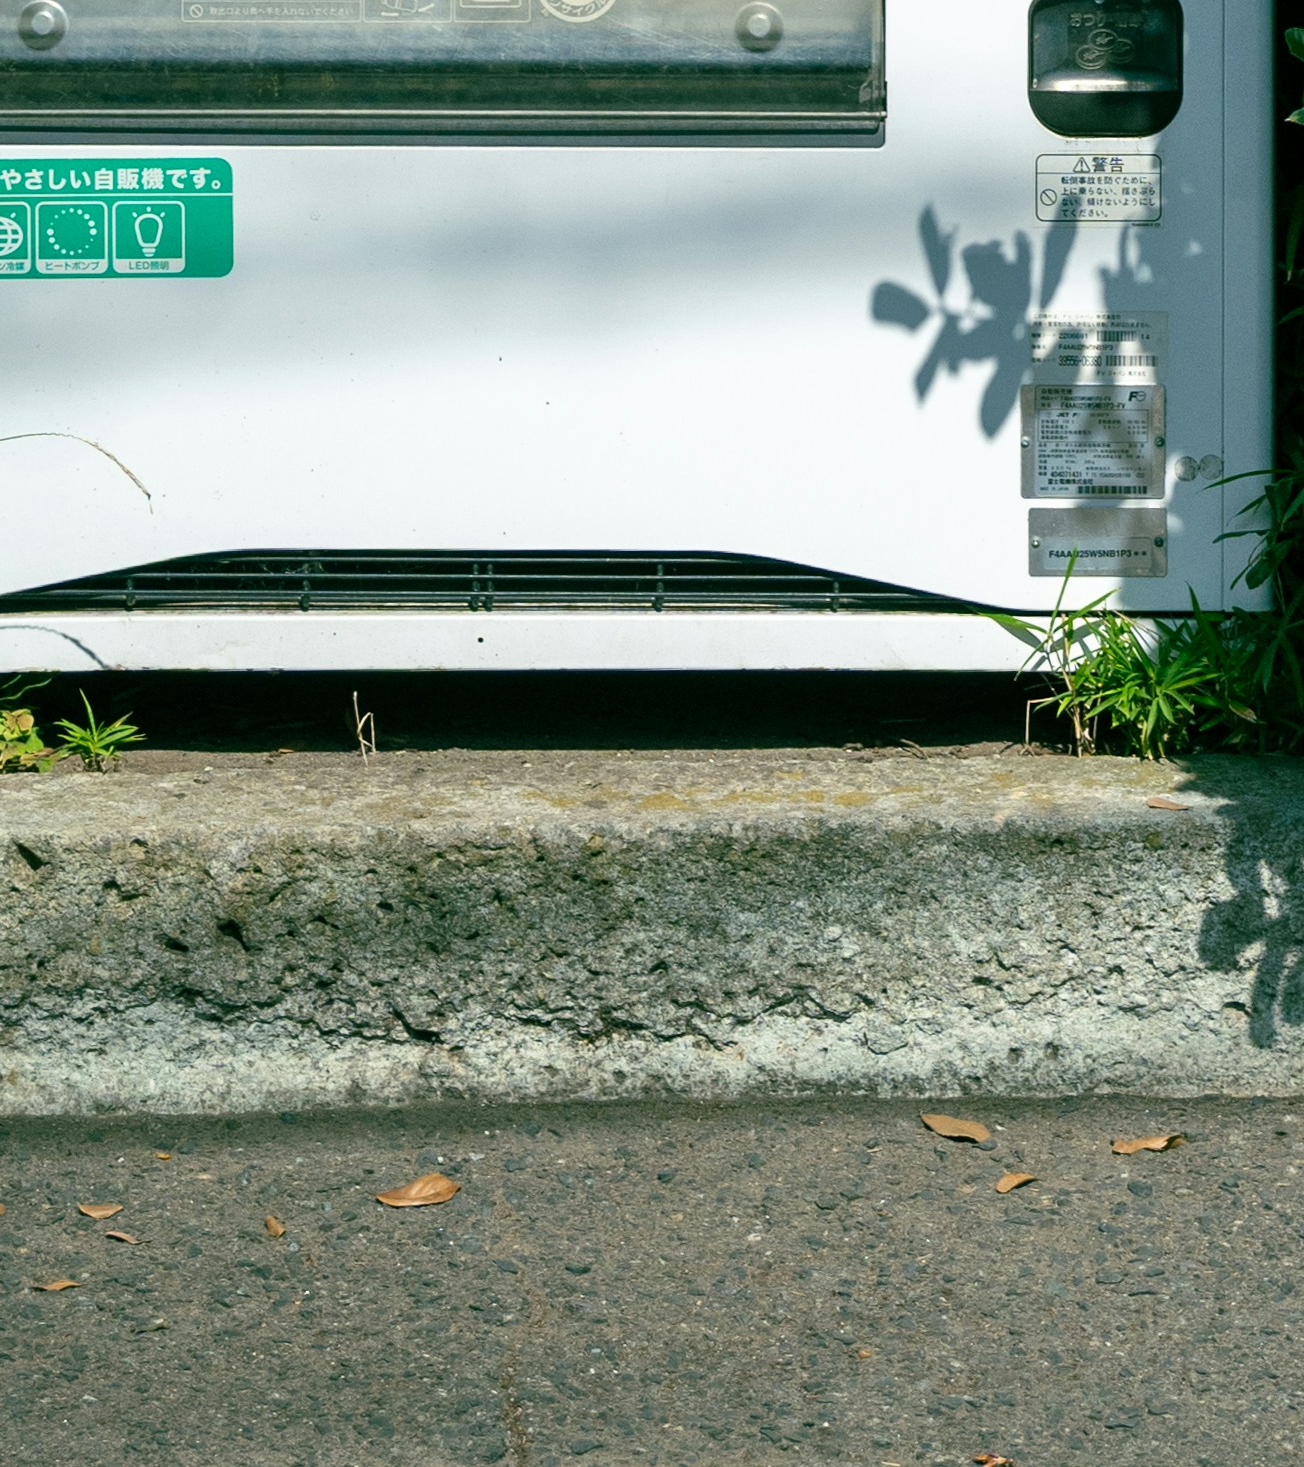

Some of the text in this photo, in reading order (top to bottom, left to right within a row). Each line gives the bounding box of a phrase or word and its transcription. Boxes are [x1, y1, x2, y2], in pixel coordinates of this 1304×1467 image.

[1092, 156, 1125, 173] 警告
[1060, 209, 1110, 218] てください。
[44, 261, 100, 272] ヒートポンプ
[128, 260, 170, 271] LED照明
